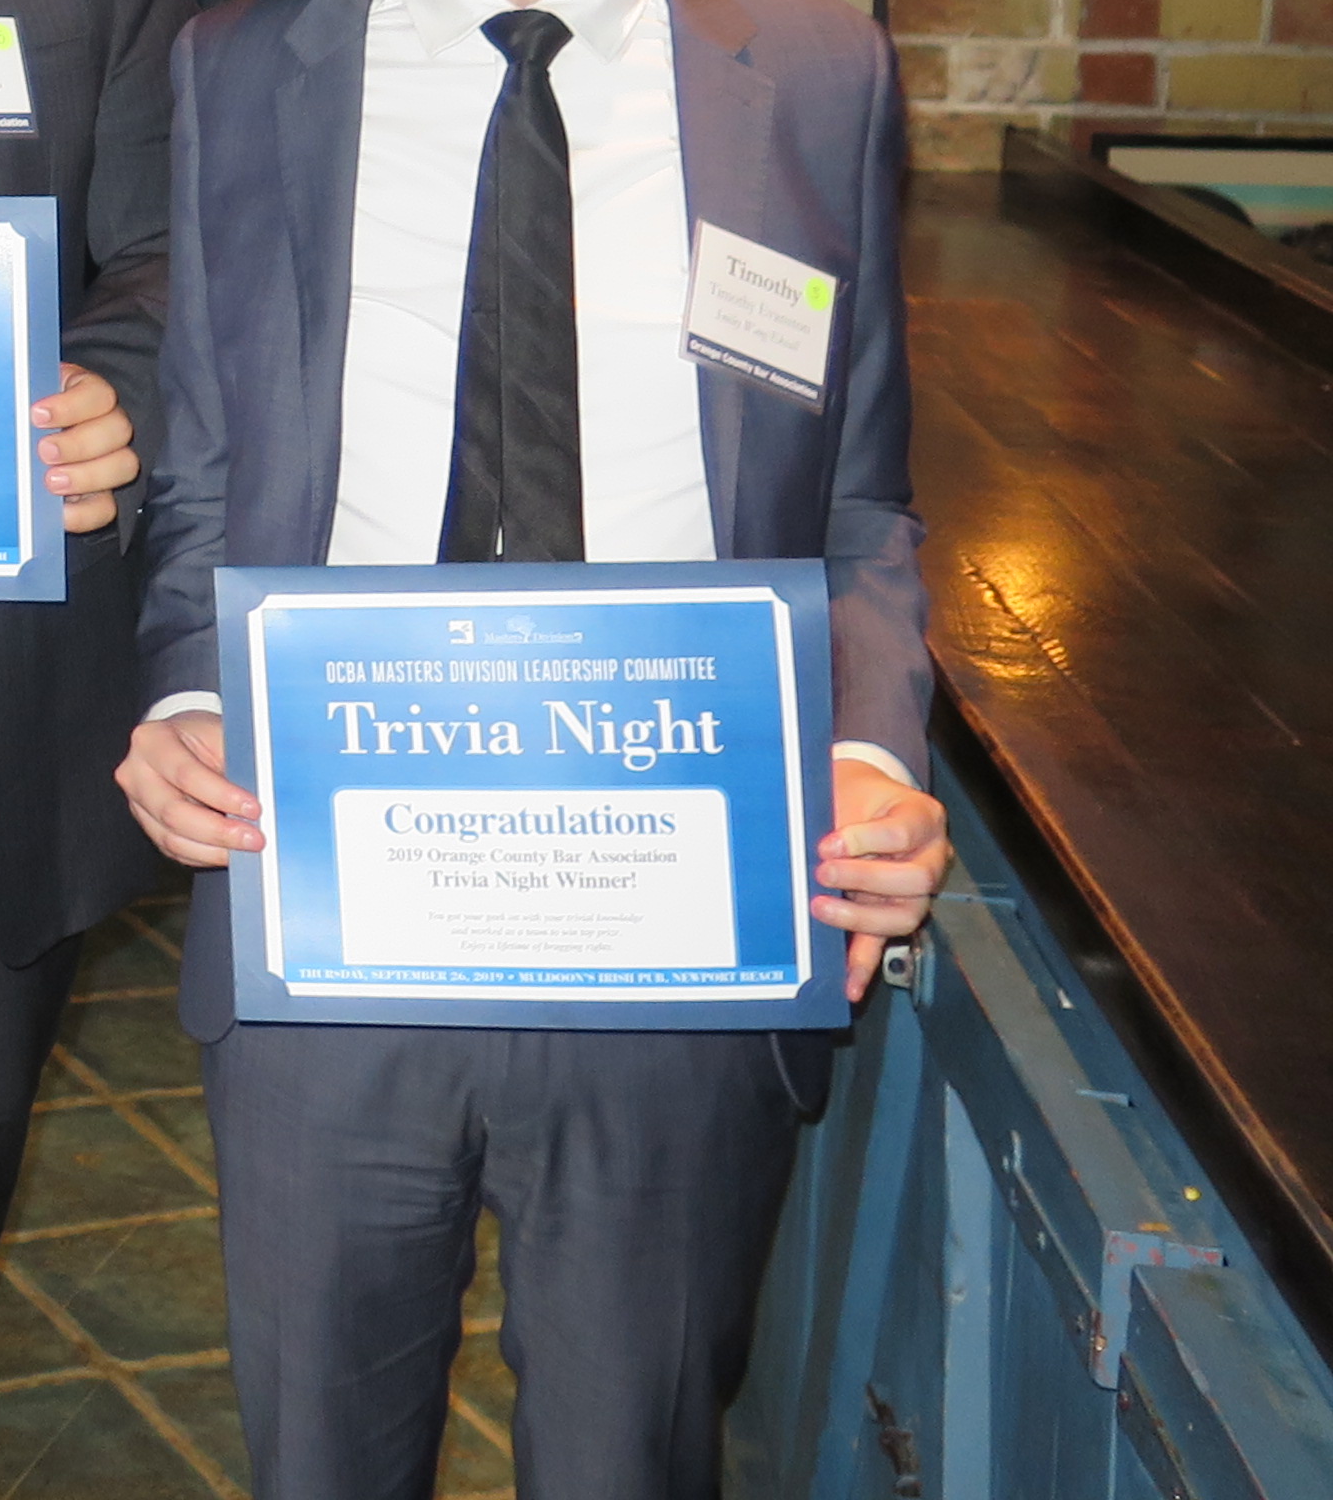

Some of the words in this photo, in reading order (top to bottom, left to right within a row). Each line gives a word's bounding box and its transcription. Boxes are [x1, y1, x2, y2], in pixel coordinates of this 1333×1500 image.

[726, 255, 803, 308] Timothy
[324, 660, 366, 683] OCBA
[371, 659, 444, 683] MASTERS
[448, 658, 518, 682] DIVISION
[522, 657, 618, 682] LEADERSHIP
[622, 656, 716, 681] COMMITTEE
[326, 699, 524, 756] Trivia
[541, 697, 725, 772] Night
[383, 802, 677, 842] Congratulations
[385, 847, 422, 863] 2019
[427, 848, 485, 865] Orange
[489, 847, 547, 865] County
[552, 847, 581, 863] Bar
[587, 847, 677, 863] Association
[428, 870, 489, 888] Trivia
[493, 870, 549, 890] Night
[553, 870, 637, 888] Winner!
